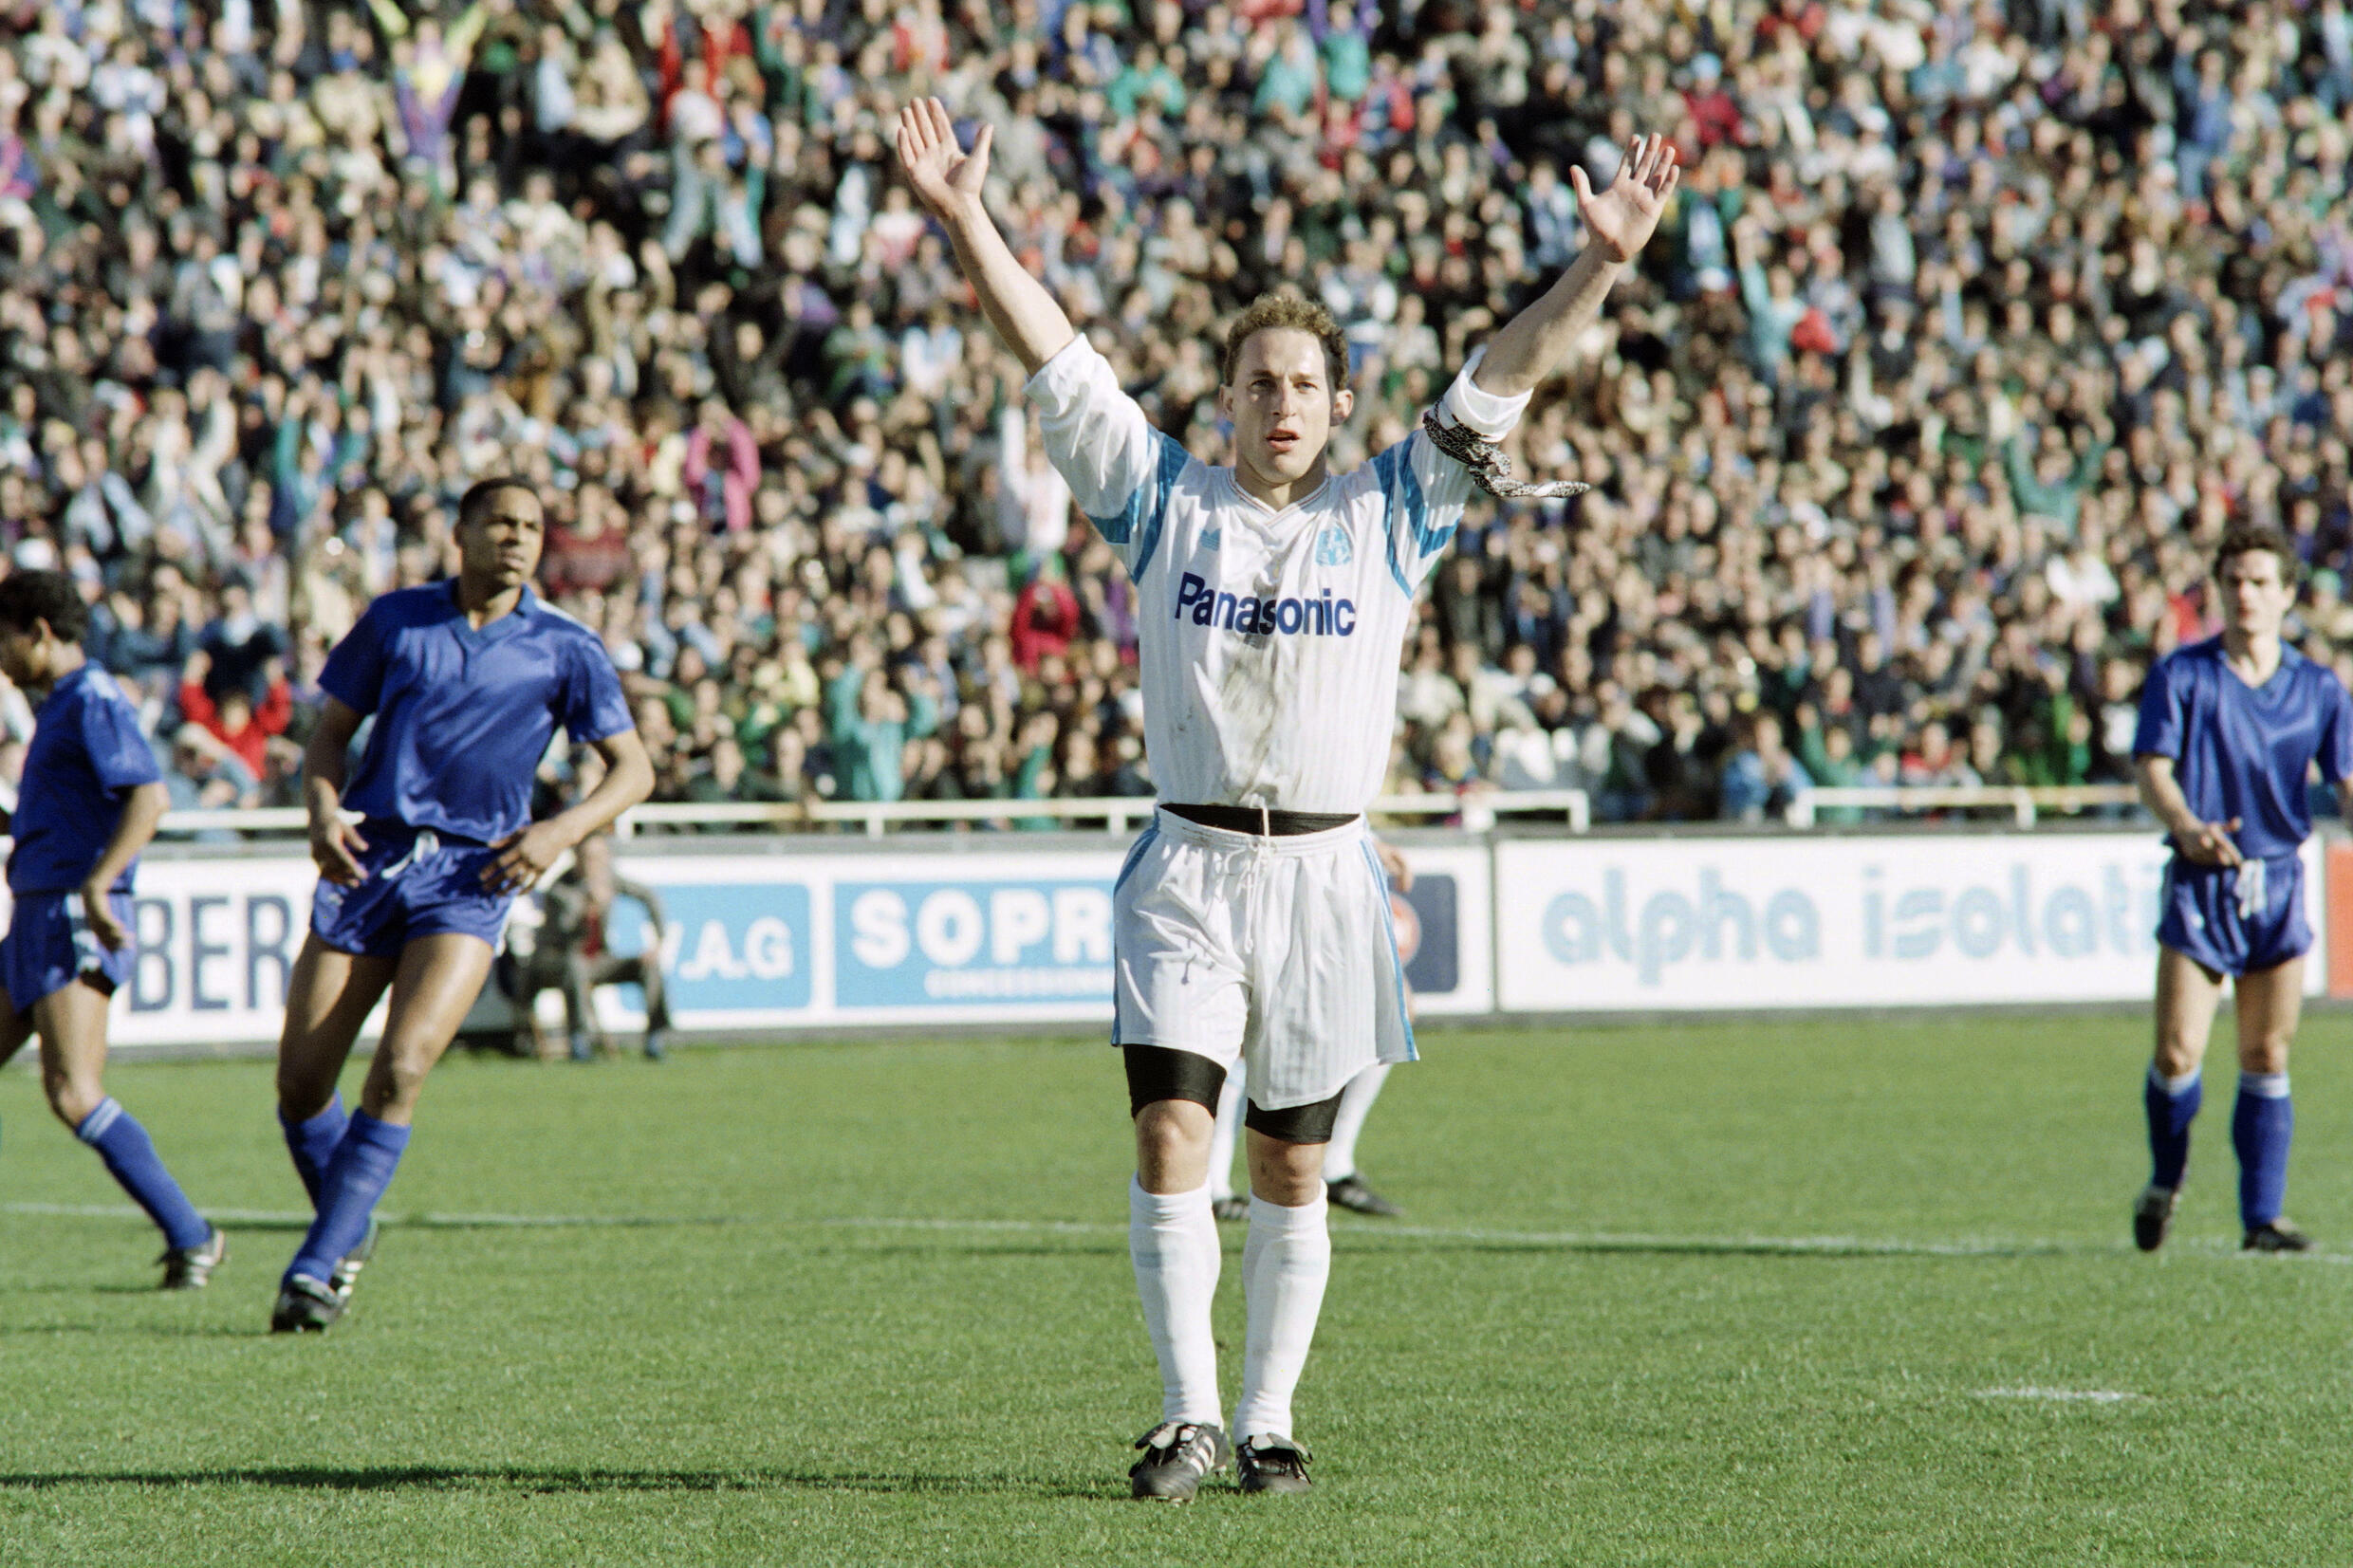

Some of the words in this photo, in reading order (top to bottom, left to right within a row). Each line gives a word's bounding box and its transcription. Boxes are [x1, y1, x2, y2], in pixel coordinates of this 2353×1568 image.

[1175, 572, 1357, 636] Panasonic
[129, 895, 292, 1011] BER
[1542, 865, 1819, 987] alpha
